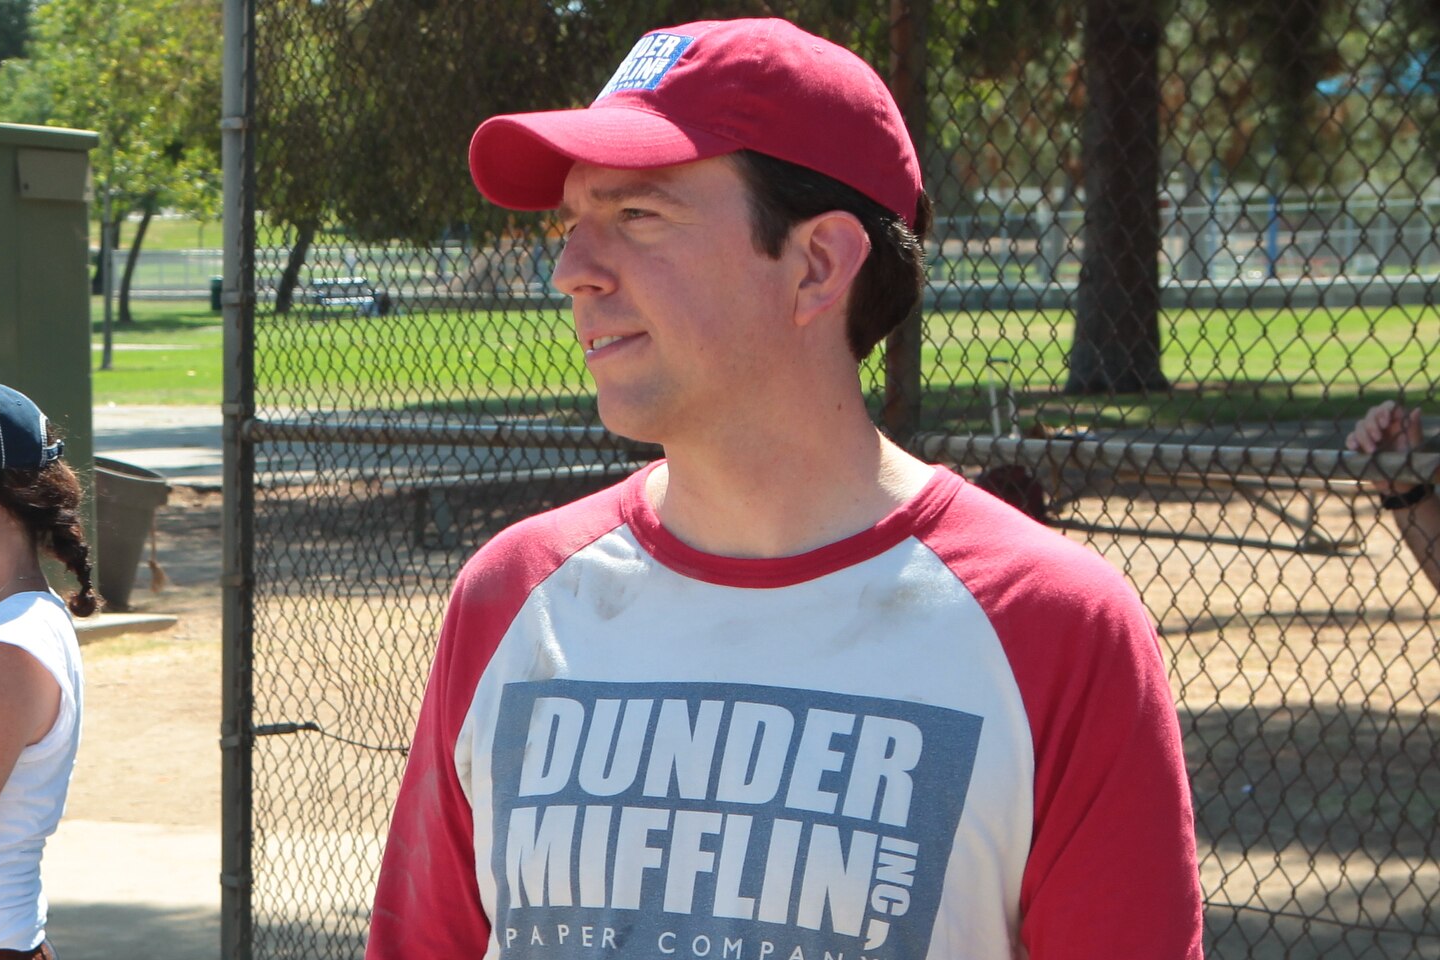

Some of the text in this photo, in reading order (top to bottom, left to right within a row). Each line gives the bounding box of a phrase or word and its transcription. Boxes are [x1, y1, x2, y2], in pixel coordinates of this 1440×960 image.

[519, 697, 923, 827] DUNDER
[872, 836, 919, 917] INC
[506, 926, 616, 949] PAPER
